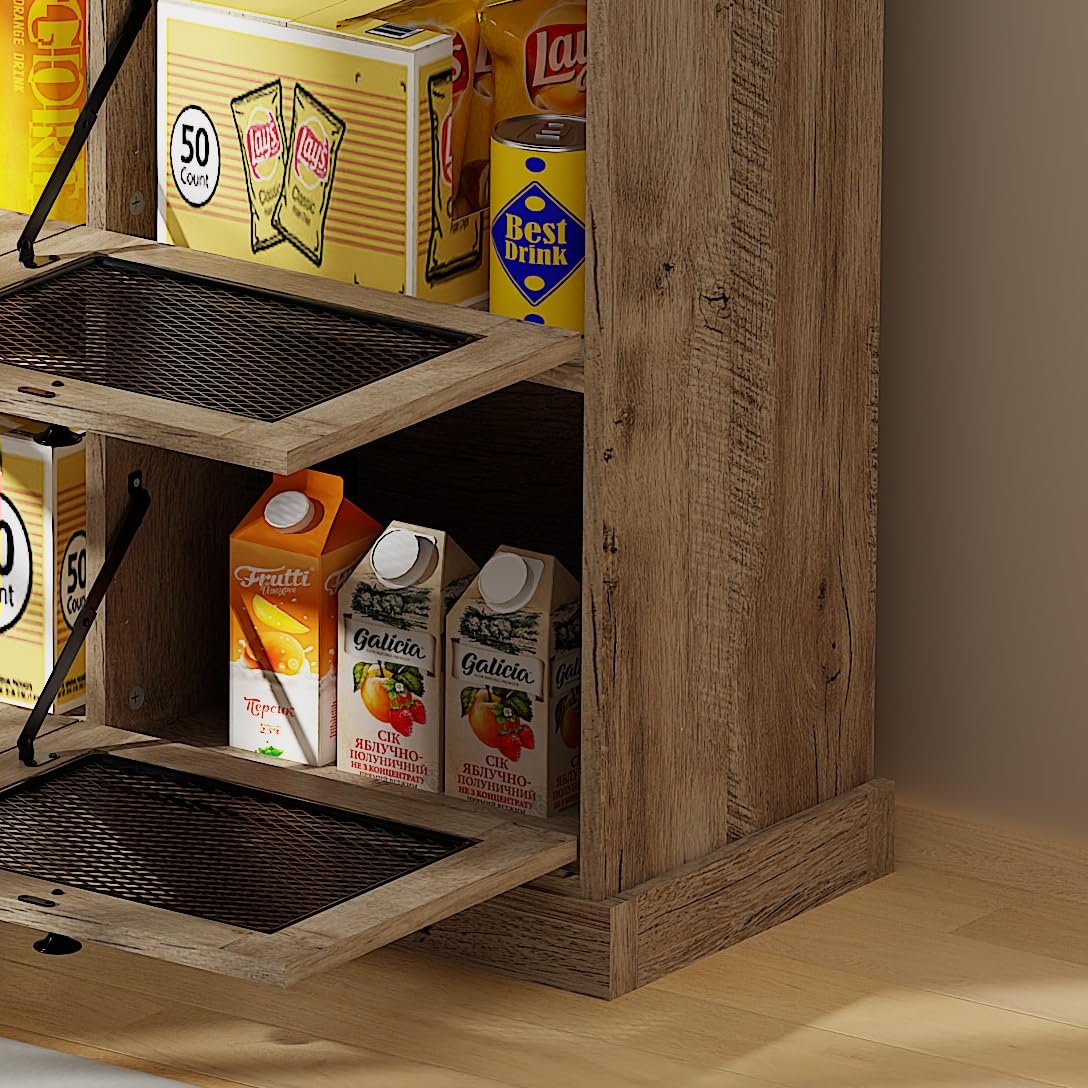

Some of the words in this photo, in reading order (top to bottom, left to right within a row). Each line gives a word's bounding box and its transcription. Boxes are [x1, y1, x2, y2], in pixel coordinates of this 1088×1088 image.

[12, 52, 25, 94] DRINK
[181, 123, 210, 167] 50
[180, 166, 209, 189] Count
[505, 212, 568, 245] Best
[504, 239, 568, 266] Drink
[67, 548, 86, 594] 50
[233, 565, 311, 588] Frutti
[353, 627, 426, 660] Galicia
[461, 652, 535, 684] Galicia
[355, 737, 424, 762] ЯБЛУЧНО-
[377, 729, 401, 745] СІК
[350, 748, 428, 776] ПОЛУНИЧНИЙ
[462, 762, 532, 788] ЯБЛУЧНО-
[485, 754, 509, 770] СІК
